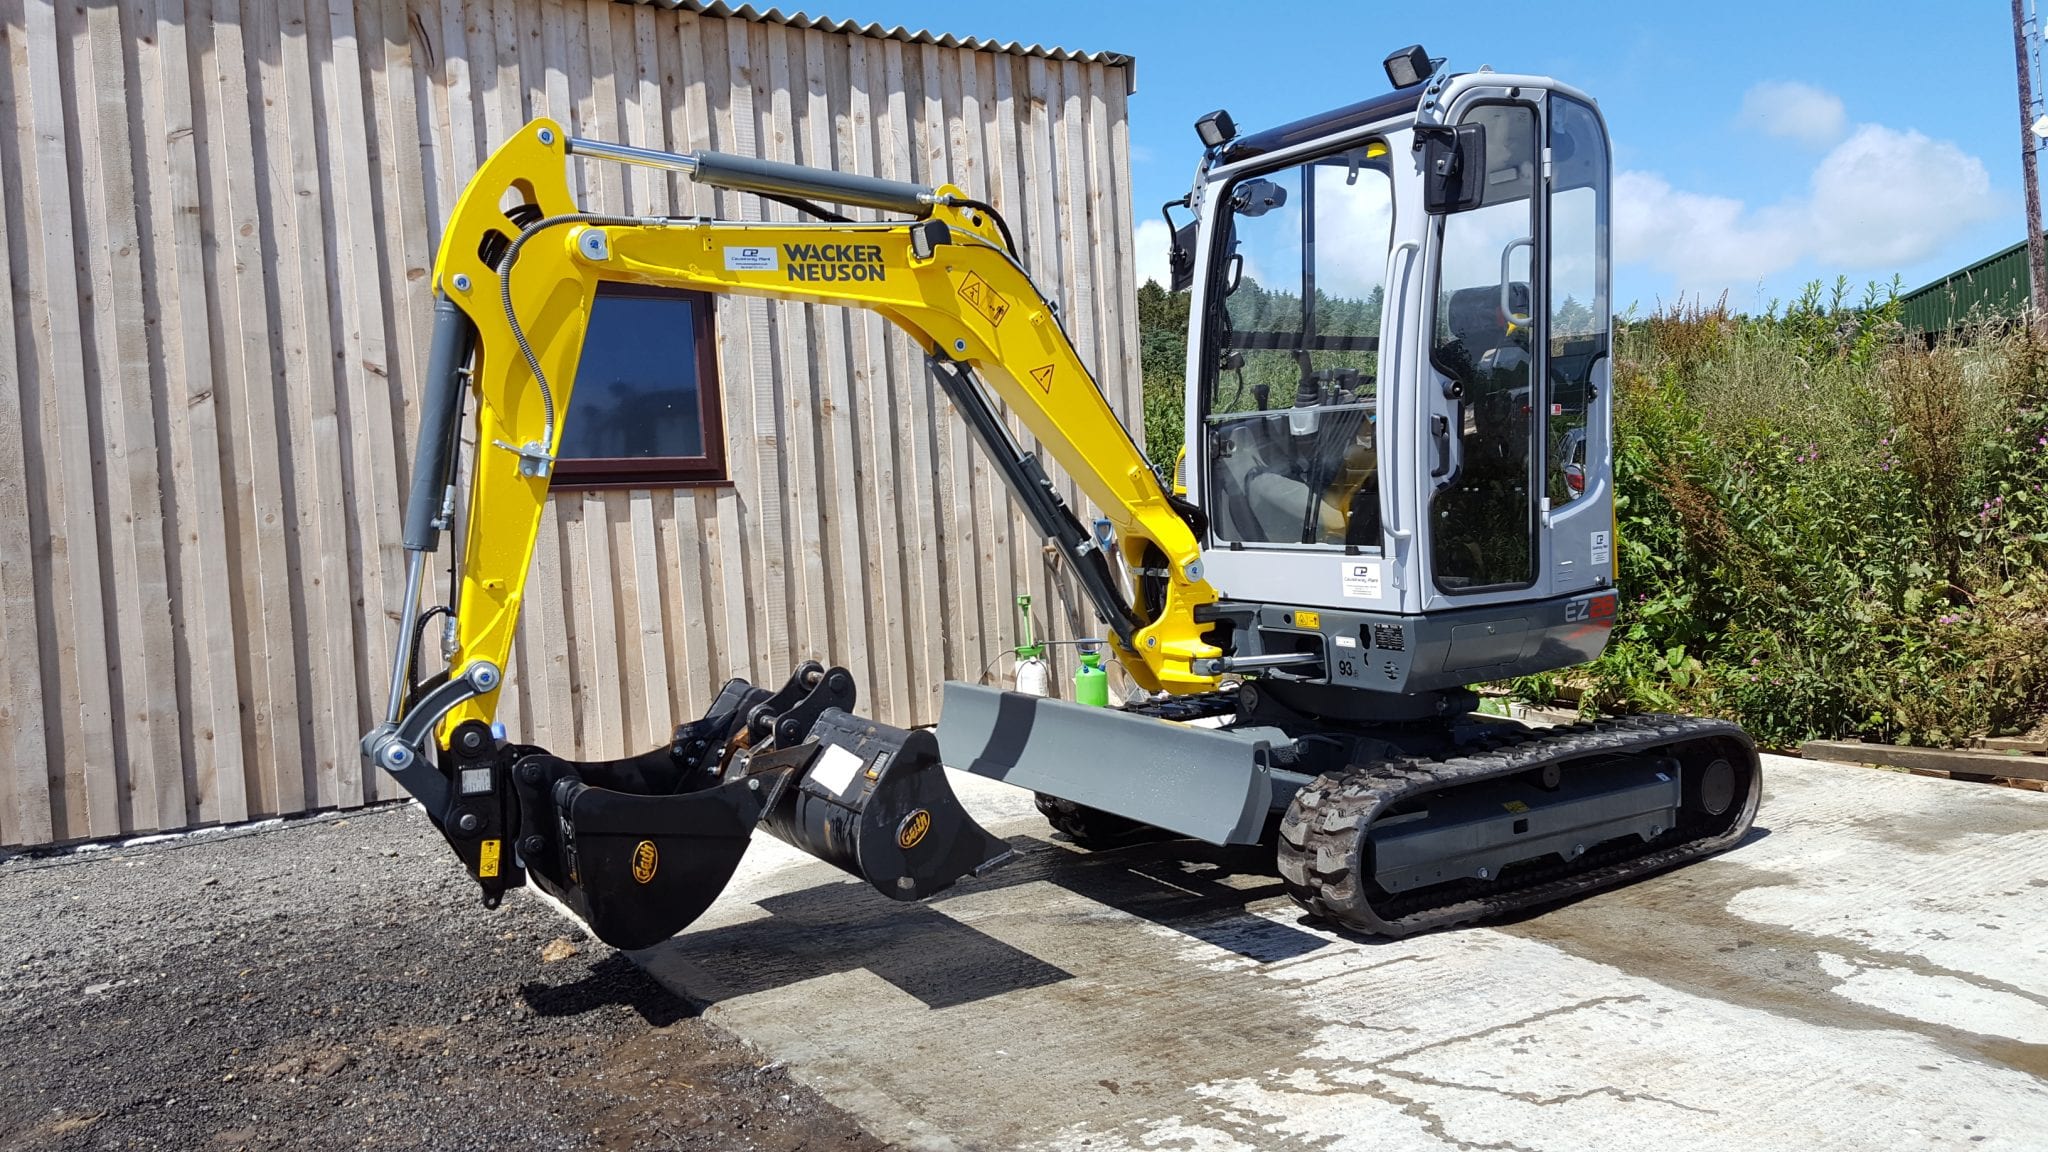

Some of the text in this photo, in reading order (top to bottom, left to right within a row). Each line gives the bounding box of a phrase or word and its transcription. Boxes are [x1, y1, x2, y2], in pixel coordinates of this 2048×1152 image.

[783, 243, 884, 262] WACKER
[787, 263, 886, 282] NEUSON
[1338, 660, 1353, 676] 93
